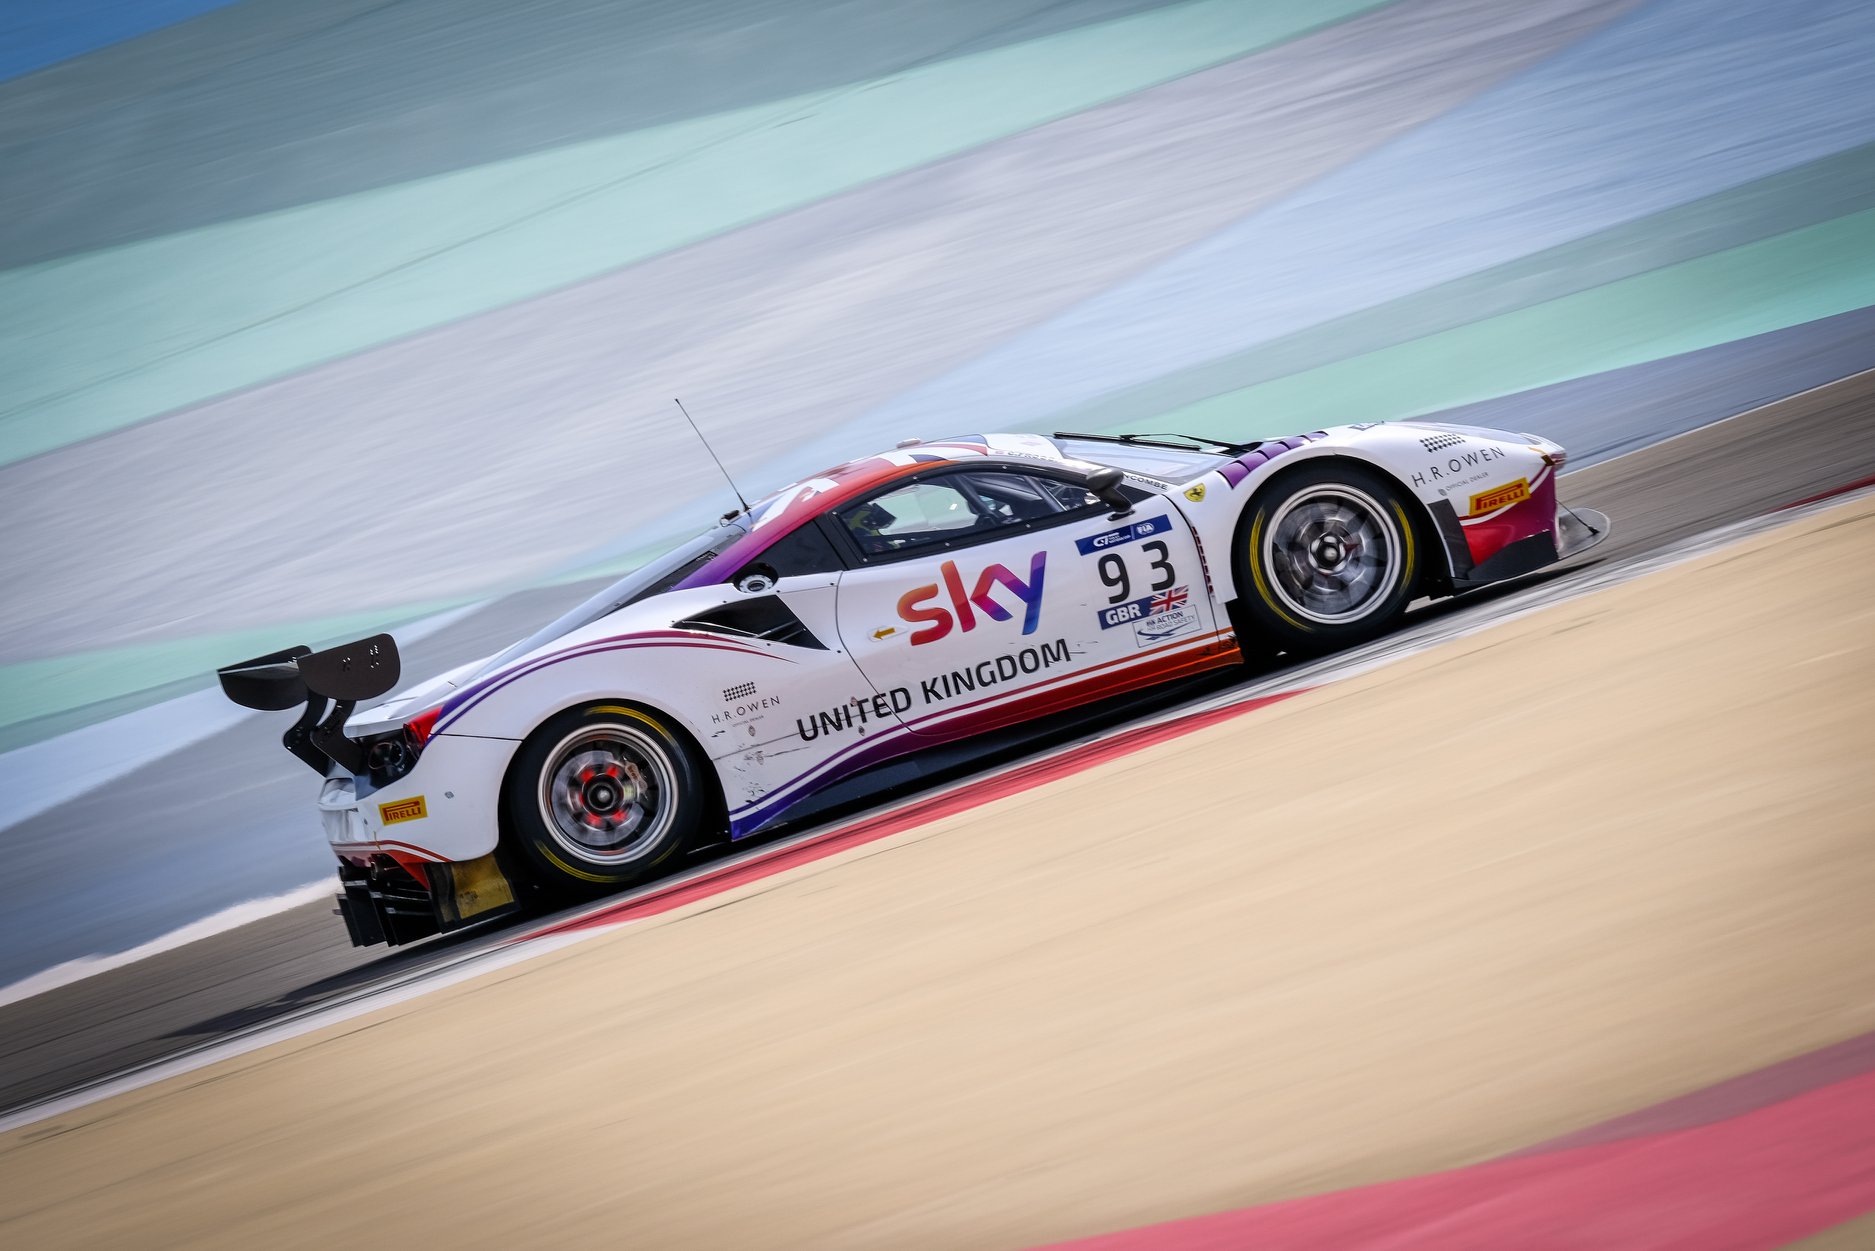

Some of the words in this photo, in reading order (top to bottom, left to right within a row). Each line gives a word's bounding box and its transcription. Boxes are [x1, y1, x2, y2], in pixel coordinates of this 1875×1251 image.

[1475, 483, 1525, 511] PIRELLI
[896, 550, 1047, 646] sky
[1105, 603, 1142, 626] GBR
[1157, 611, 1184, 624] ACTION
[796, 687, 912, 742] UNITED
[920, 638, 1071, 704] KINGDOM
[382, 800, 422, 822] PIRELLI
